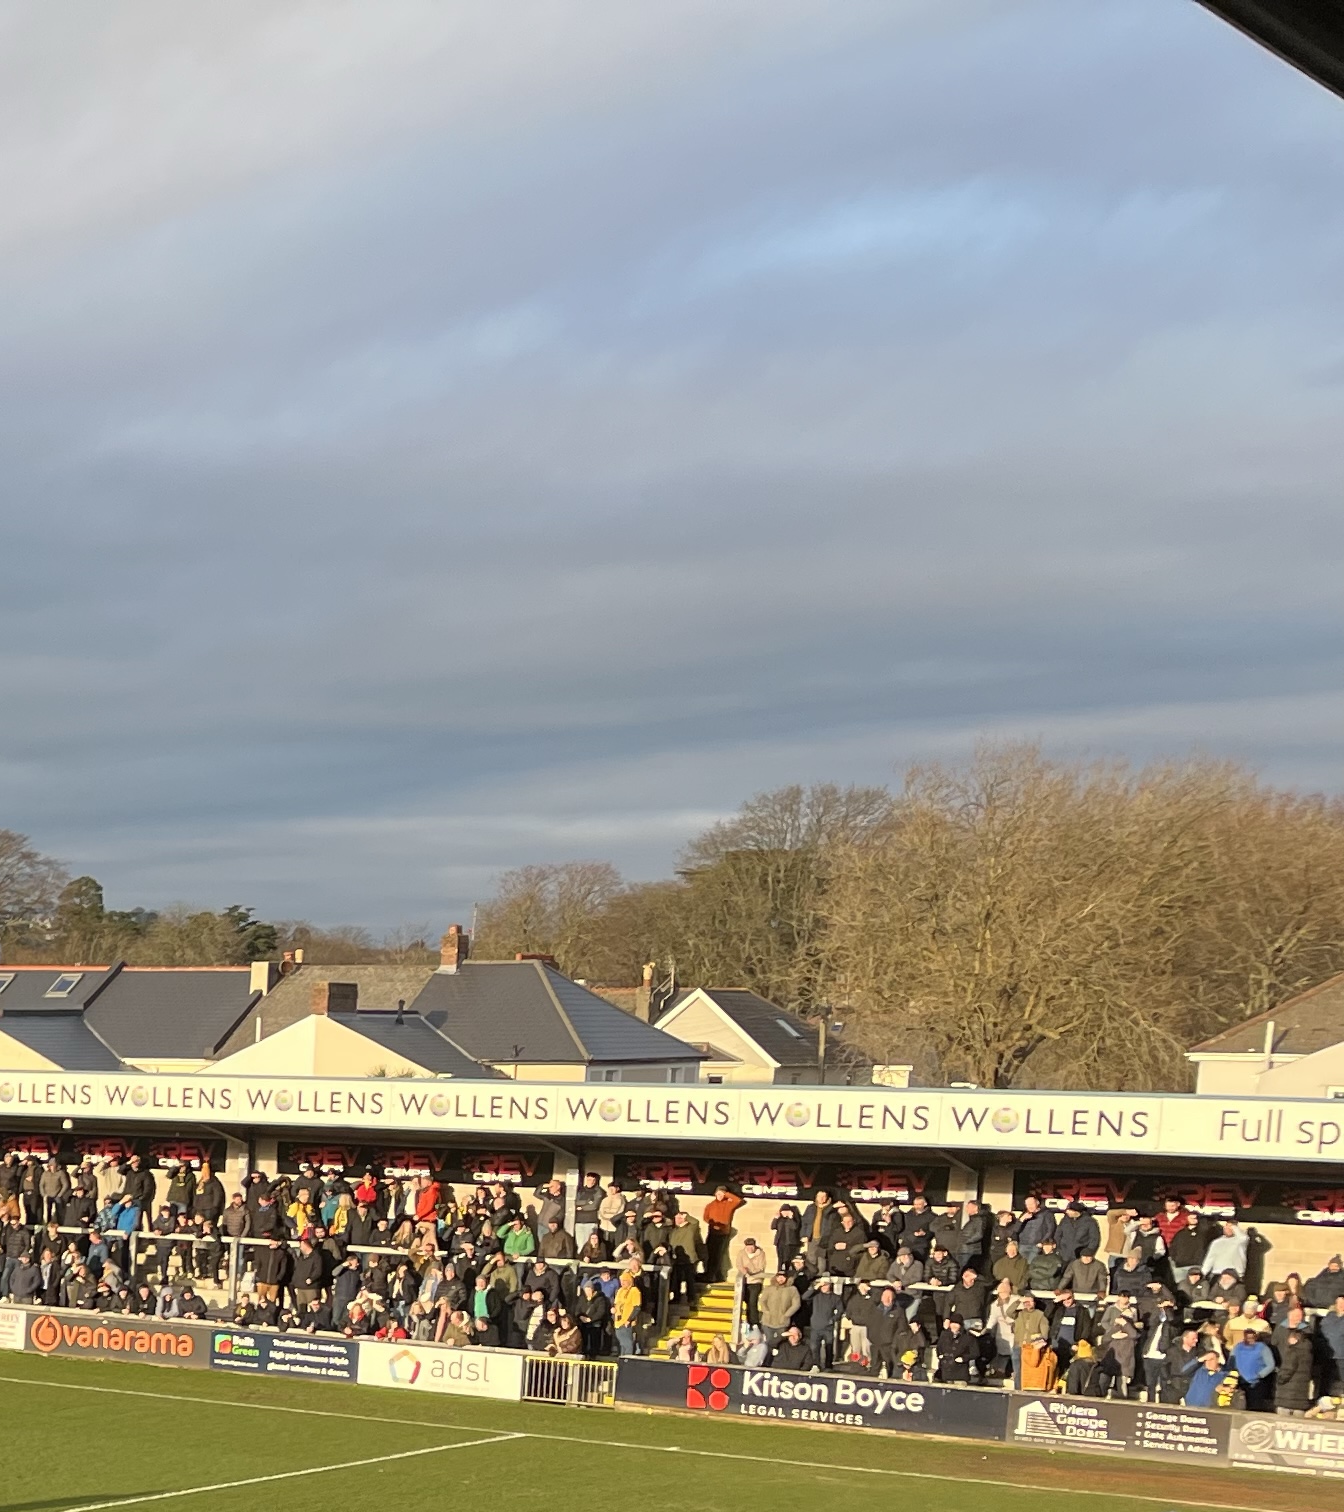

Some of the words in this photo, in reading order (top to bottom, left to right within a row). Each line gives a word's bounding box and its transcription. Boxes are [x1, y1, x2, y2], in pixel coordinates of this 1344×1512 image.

[105, 1083, 233, 1110] WOLLENS
[245, 1088, 384, 1115] WOLLENS
[398, 1092, 549, 1120] WOLLENS
[565, 1096, 731, 1126] WOLLENS
[748, 1100, 930, 1132] WOLLENS
[951, 1104, 1150, 1138] WOLLENS
[1218, 1109, 1283, 1144] Full
[62, 1323, 194, 1358] vanarama
[232, 1346, 260, 1357] Green
[430, 1354, 490, 1383] adsl
[742, 1370, 829, 1402] Kitson
[835, 1379, 925, 1414] Boyce
[740, 1403, 786, 1418] LEGAL
[791, 1408, 863, 1426] SERVICES
[1049, 1402, 1098, 1417] Riviera
[1056, 1414, 1108, 1429] Garage
[1146, 1412, 1178, 1423] Garage
[1179, 1415, 1207, 1425] Doors
[1066, 1426, 1108, 1439] Doors
[1182, 1425, 1209, 1435] Doors
[1166, 1433, 1218, 1445] Automation
[1142, 1440, 1175, 1451] Service
[1186, 1444, 1218, 1455] Advice
